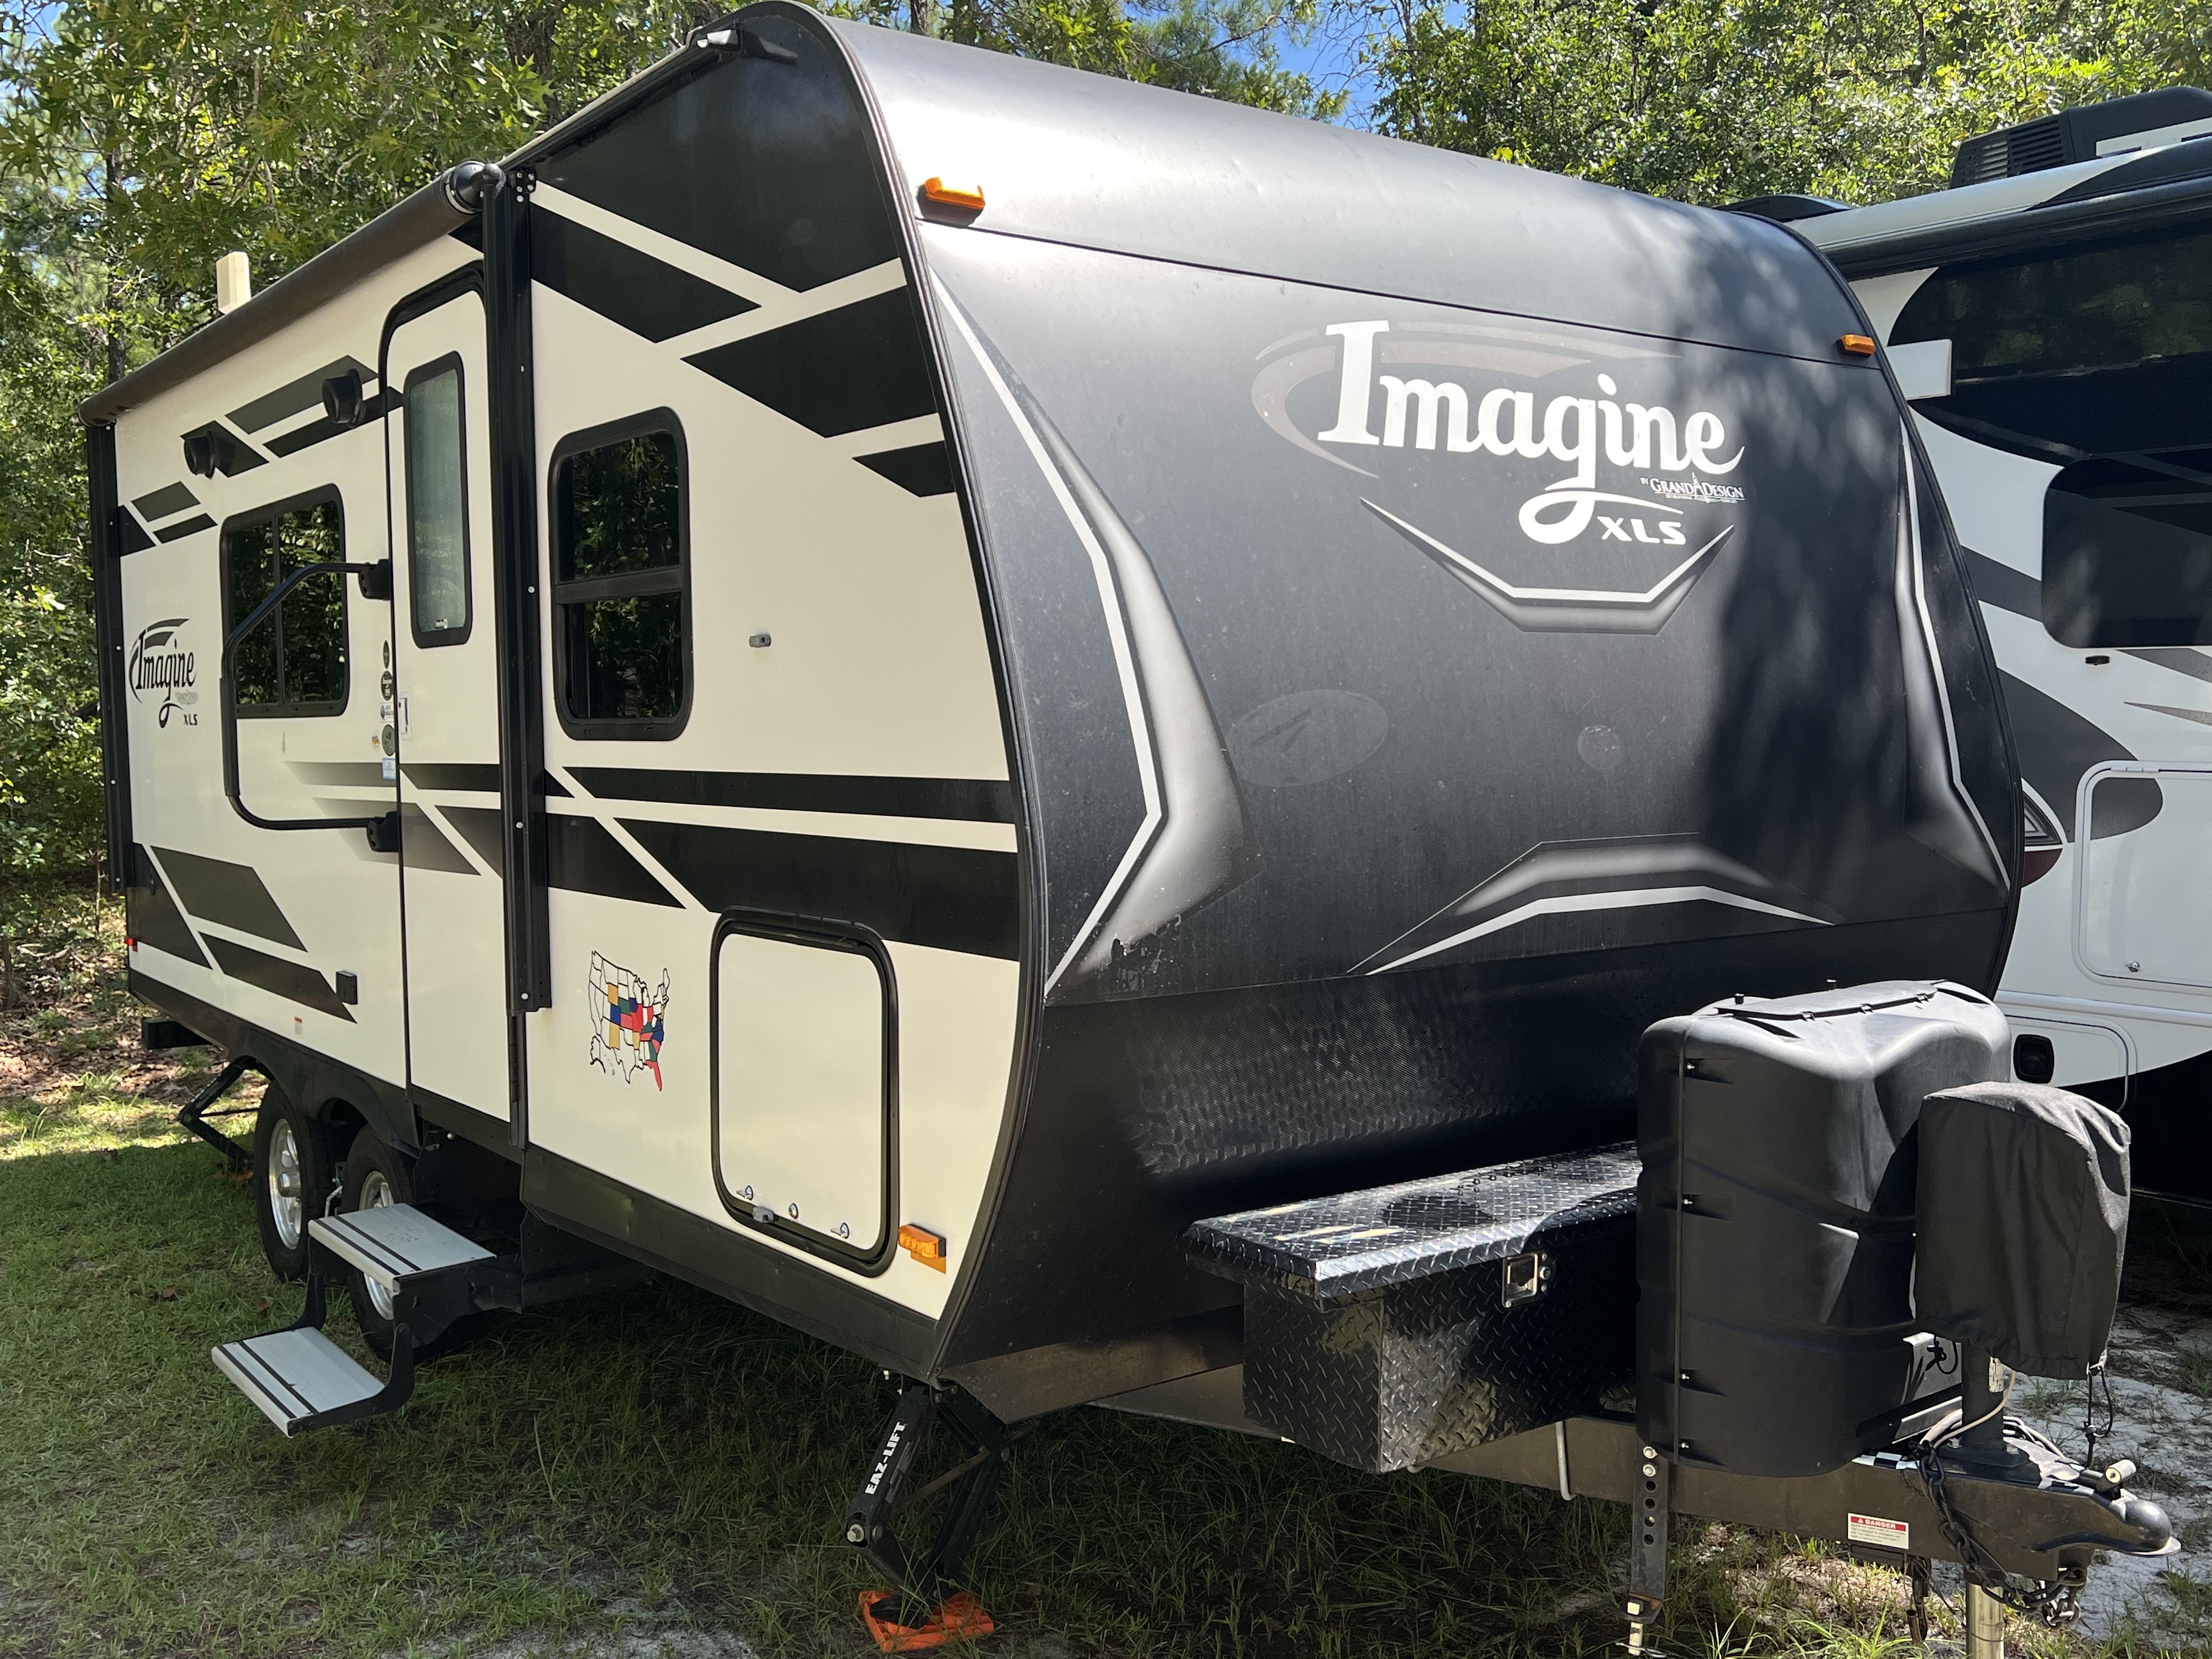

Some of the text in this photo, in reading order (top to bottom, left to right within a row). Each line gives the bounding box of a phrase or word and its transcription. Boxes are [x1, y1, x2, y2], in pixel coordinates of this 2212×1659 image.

[1317, 320, 1745, 544] Imagine
[1650, 478, 1694, 494] GRAND
[1701, 482, 1745, 499] DESIGN
[1597, 516, 1686, 545] XLS
[135, 629, 198, 729] Imagine
[183, 714, 198, 726] XLS
[865, 1421, 906, 1495] EAZ-LIFT
[1865, 1519, 1897, 1530] DANGER
